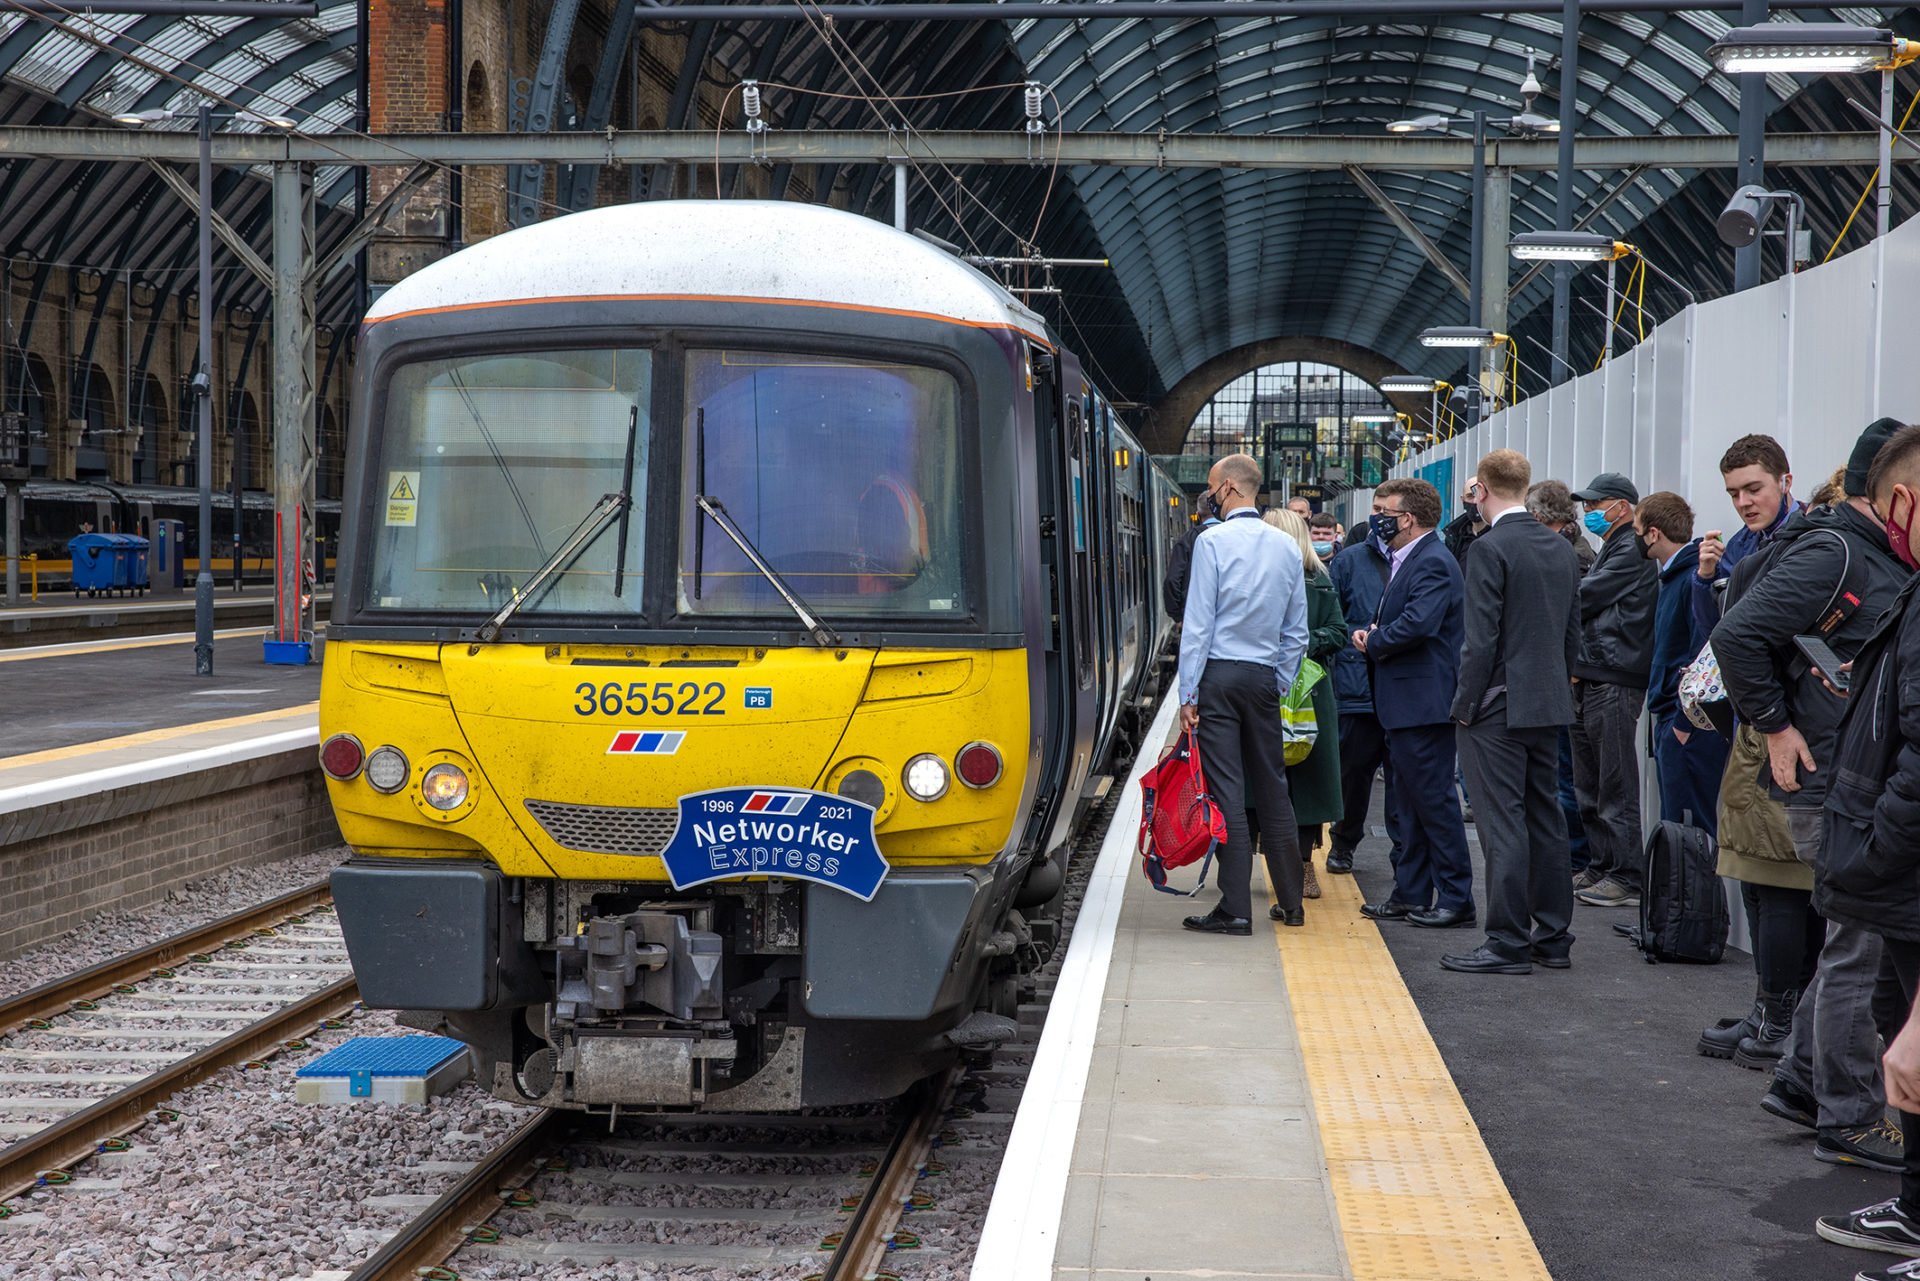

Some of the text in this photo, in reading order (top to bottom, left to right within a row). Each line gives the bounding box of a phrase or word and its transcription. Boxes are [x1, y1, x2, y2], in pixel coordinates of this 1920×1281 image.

[573, 682, 726, 716] 365522
[750, 696, 766, 706] PB
[701, 799, 852, 820] 1996 2021
[692, 818, 860, 855] Networker
[708, 845, 840, 877] Express
